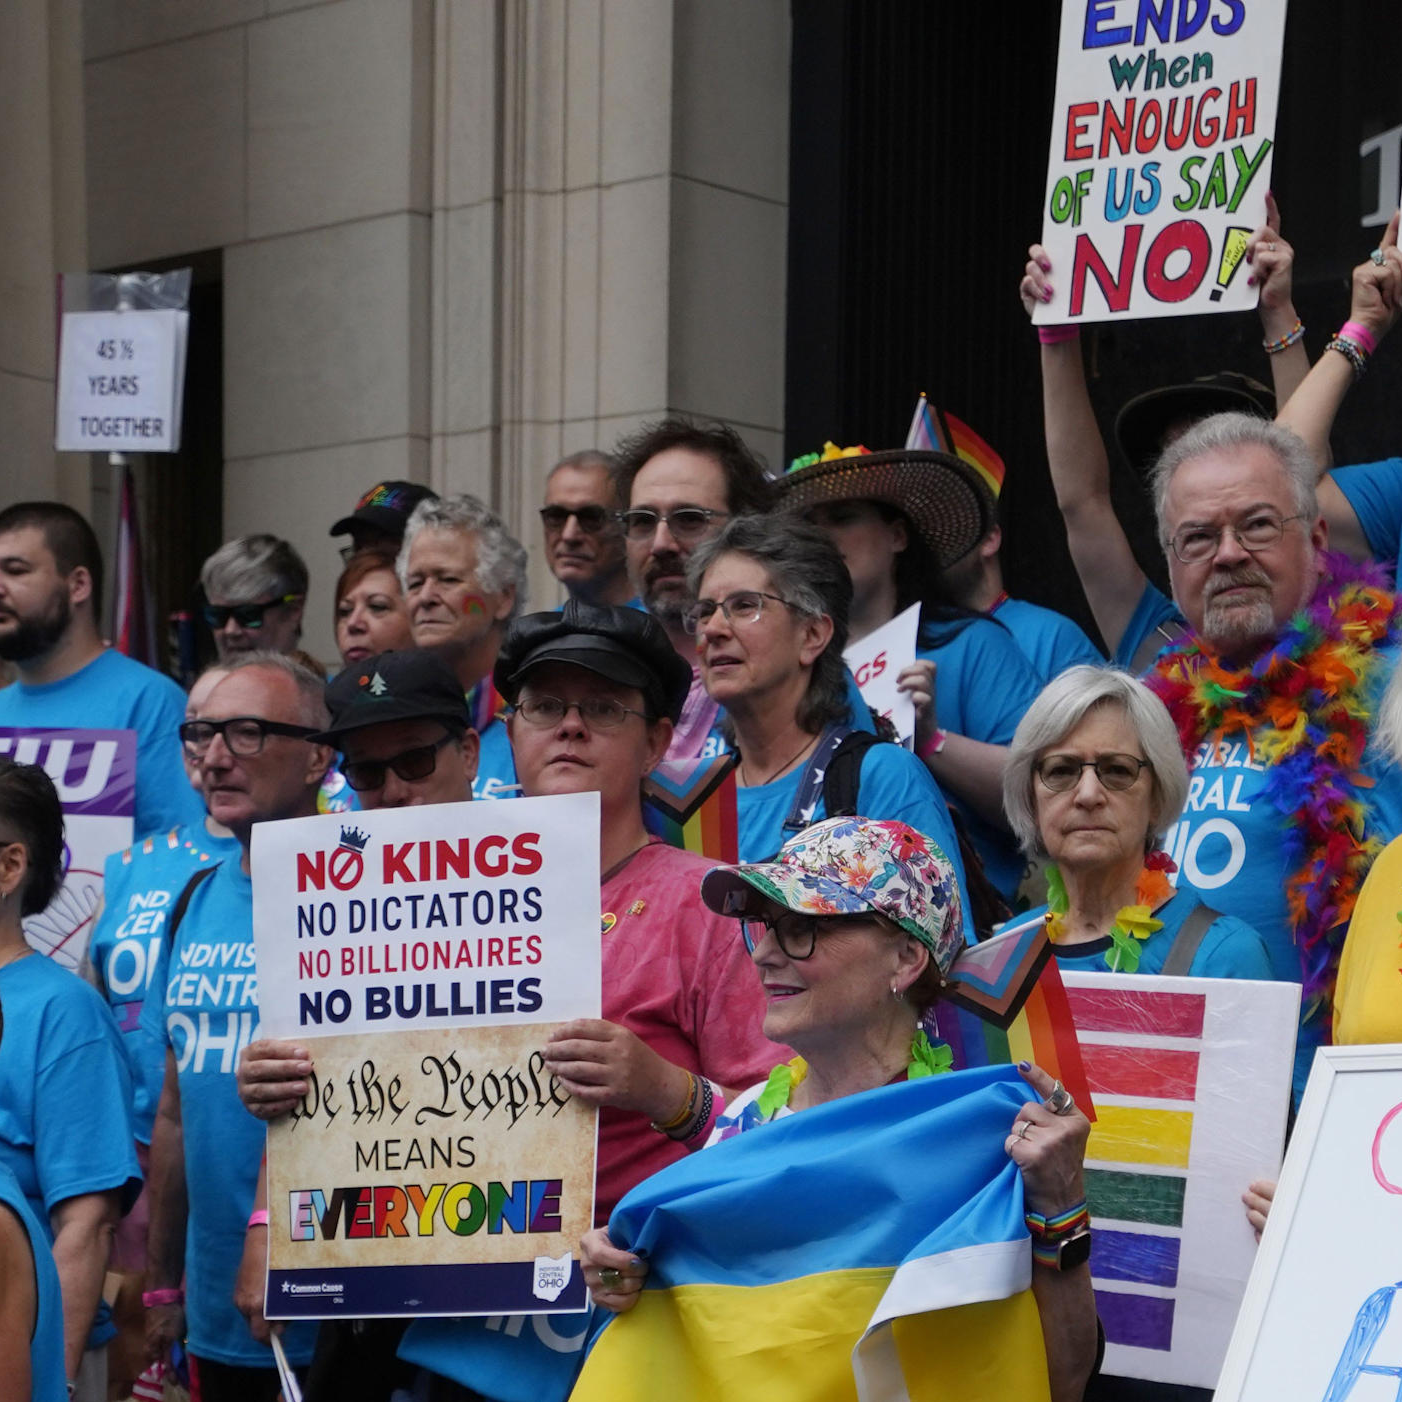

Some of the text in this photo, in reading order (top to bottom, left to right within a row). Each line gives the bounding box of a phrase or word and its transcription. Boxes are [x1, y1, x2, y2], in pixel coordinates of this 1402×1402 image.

[1063, 77, 1258, 162] ENOUGH
[1050, 138, 1273, 227] OF US SAY
[1068, 219, 1254, 318] NO!
[97, 339, 116, 360] 45
[88, 375, 140, 396] YEARS
[80, 415, 164, 438] TOGETHER
[297, 832, 543, 893] NO KINGS
[298, 886, 542, 938] NO DICTATORS
[299, 934, 542, 980] NO BILLIONAIRES
[166, 973, 259, 1006] CENTR
[300, 977, 542, 1026] NO BULLIES
[346, 1050, 573, 1130] the People
[355, 1136, 476, 1172] MEANS
[289, 1179, 562, 1242] EVERYONE
[538, 1279, 565, 1290] OHIO
